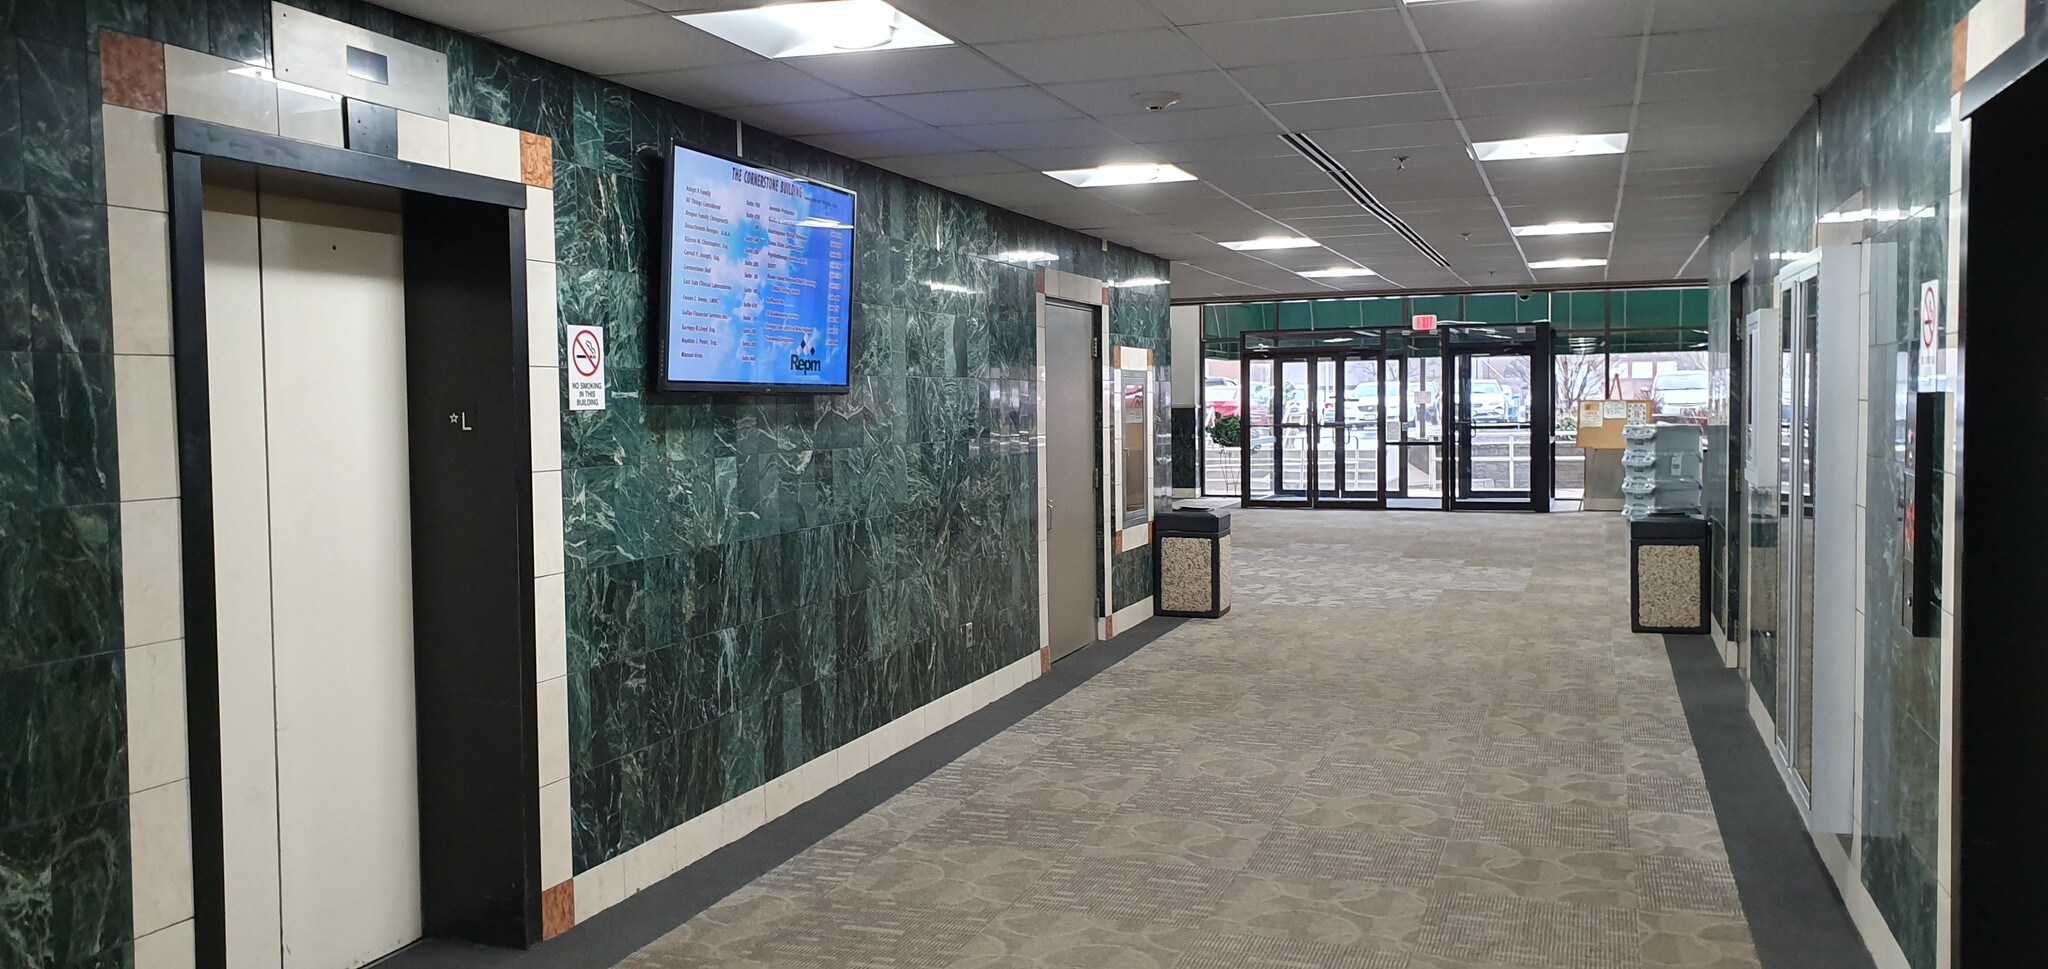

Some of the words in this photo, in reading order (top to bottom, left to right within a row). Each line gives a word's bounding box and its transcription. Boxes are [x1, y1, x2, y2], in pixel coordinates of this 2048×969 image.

[732, 167, 742, 182] THE
[744, 170, 779, 192] CORNERSTONE
[780, 180, 803, 198] BUILDING
[700, 189, 711, 198] Family
[692, 198, 702, 207] Things
[703, 201, 721, 210] Considered
[791, 354, 821, 376] Repm
[572, 382, 579, 390] NO
[580, 382, 602, 390] SMOKING
[579, 390, 584, 398] IN
[576, 398, 599, 407] BUILDING
